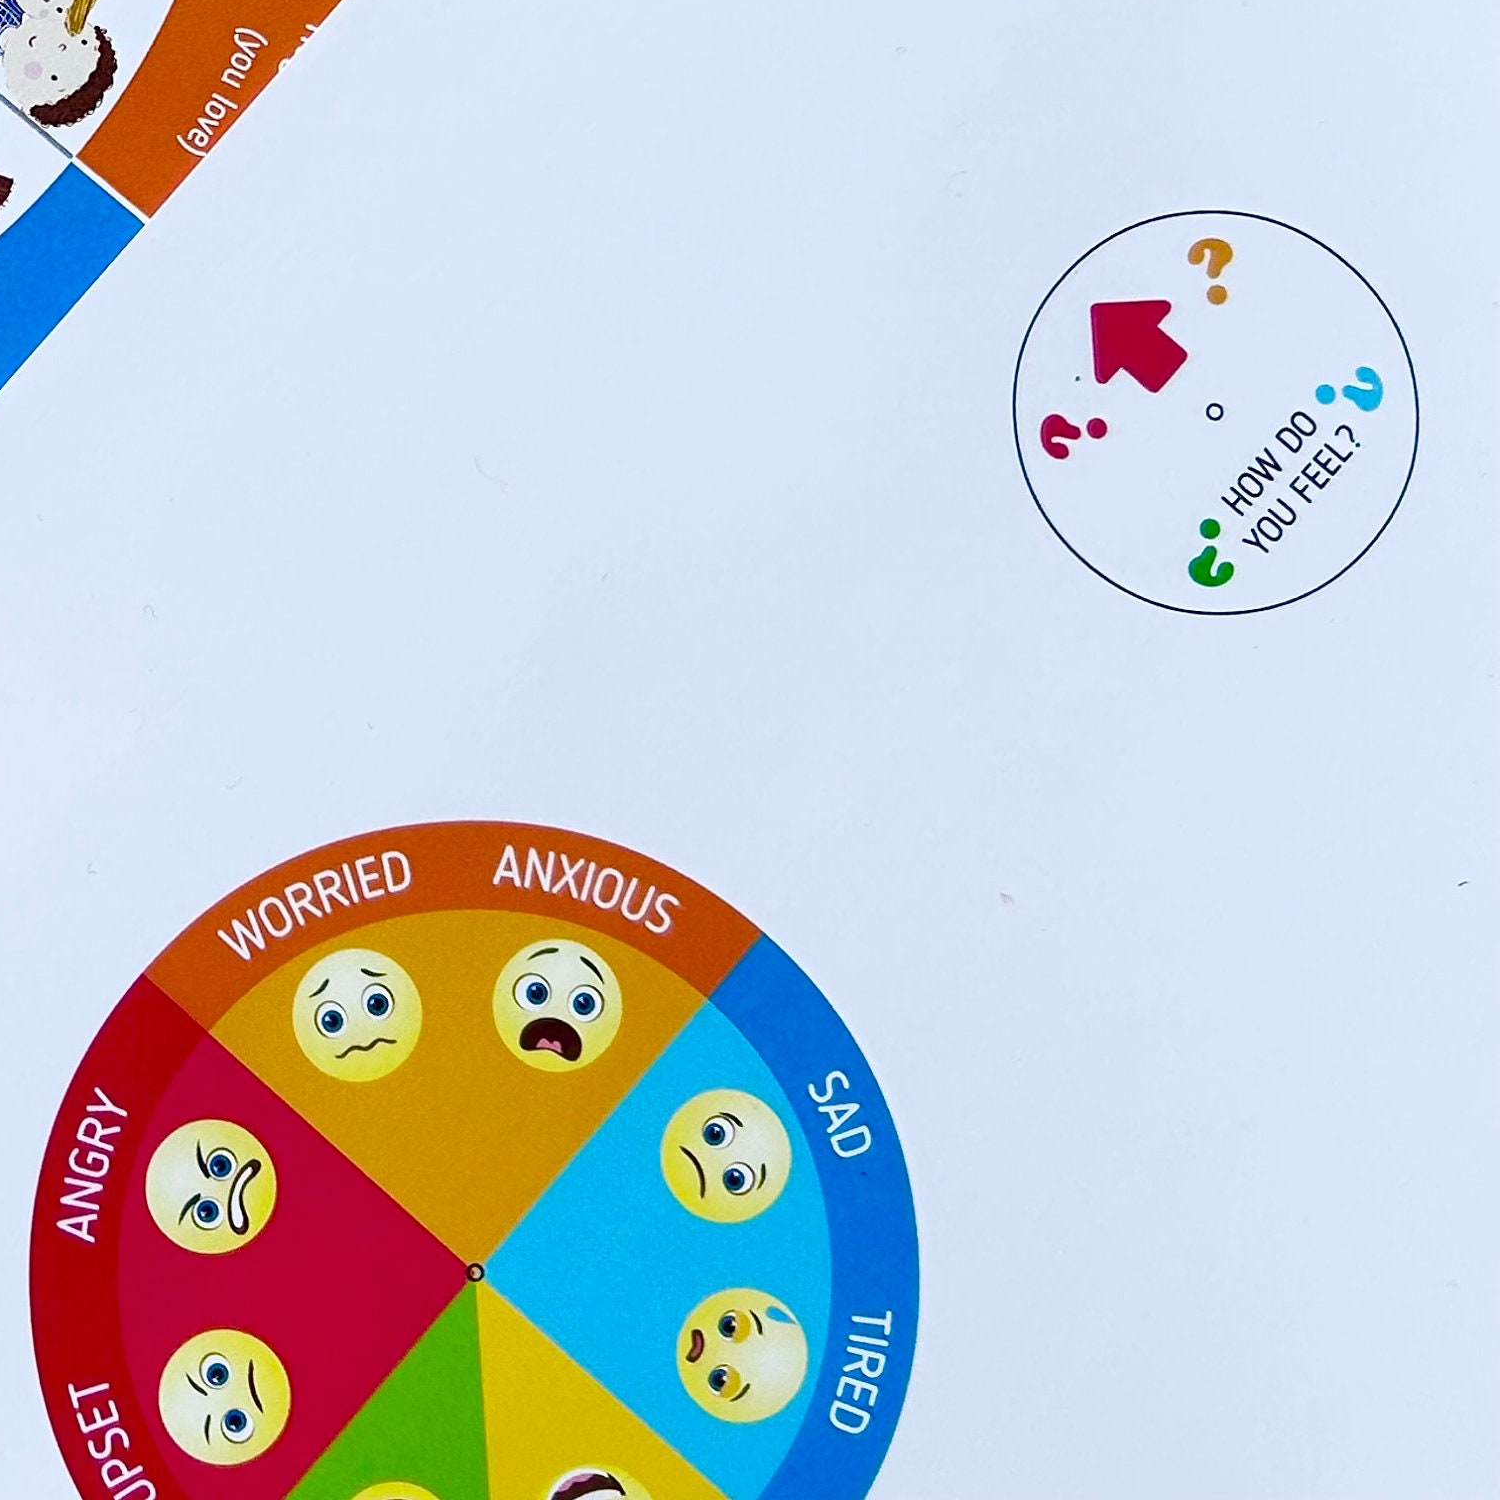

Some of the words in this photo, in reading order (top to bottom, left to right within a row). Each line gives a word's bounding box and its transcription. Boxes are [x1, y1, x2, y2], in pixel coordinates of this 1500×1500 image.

[220, 27, 269, 89] (you
[176, 92, 239, 157] love)
[1220, 447, 1283, 517] HOW
[1275, 411, 1317, 454] DO
[1241, 498, 1297, 554] YOU
[1288, 424, 1362, 504] FEEL?
[217, 850, 412, 961] WORRIED
[494, 843, 681, 934] ANXIOUS
[56, 1087, 130, 1243] ANGRY
[808, 1069, 872, 1160] SAD
[830, 1308, 893, 1437] TIRED
